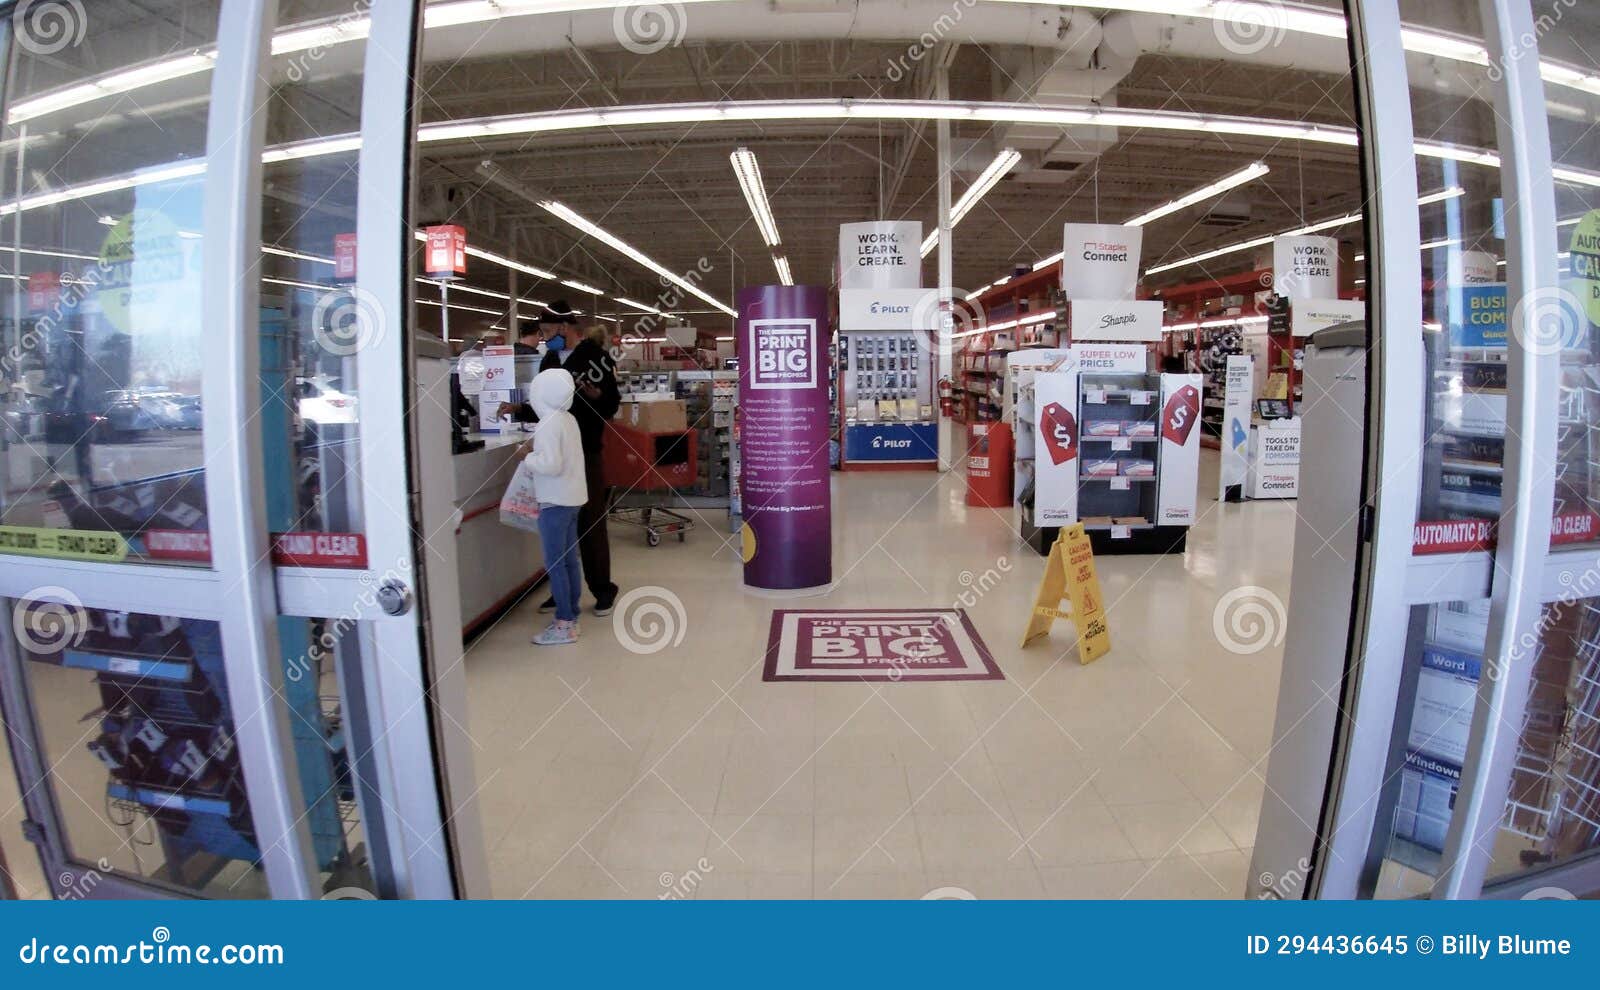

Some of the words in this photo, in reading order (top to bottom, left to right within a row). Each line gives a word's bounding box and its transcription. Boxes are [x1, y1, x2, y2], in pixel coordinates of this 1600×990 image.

[858, 233, 899, 243] WORK.
[858, 245, 900, 255] LEARN.
[858, 256, 906, 267] CREATE.
[1083, 251, 1128, 262] Connect
[881, 305, 909, 314] PILOT
[1100, 313, 1137, 329] Sharpie
[759, 335, 807, 349] PRINT
[1080, 351, 1111, 359] SUPER
[1114, 351, 1136, 359] LOW
[759, 351, 808, 372] BIG
[1080, 360, 1115, 368] PRICES
[884, 440, 911, 448] PILOT
[1262, 482, 1295, 490] Connect
[1564, 515, 1592, 534] CLEAR
[1413, 522, 1476, 546] AUTOMATIC
[812, 626, 937, 637] PRINT
[811, 637, 946, 658] BIG
[1432, 654, 1465, 671] Word
[1405, 752, 1460, 779] Windows
